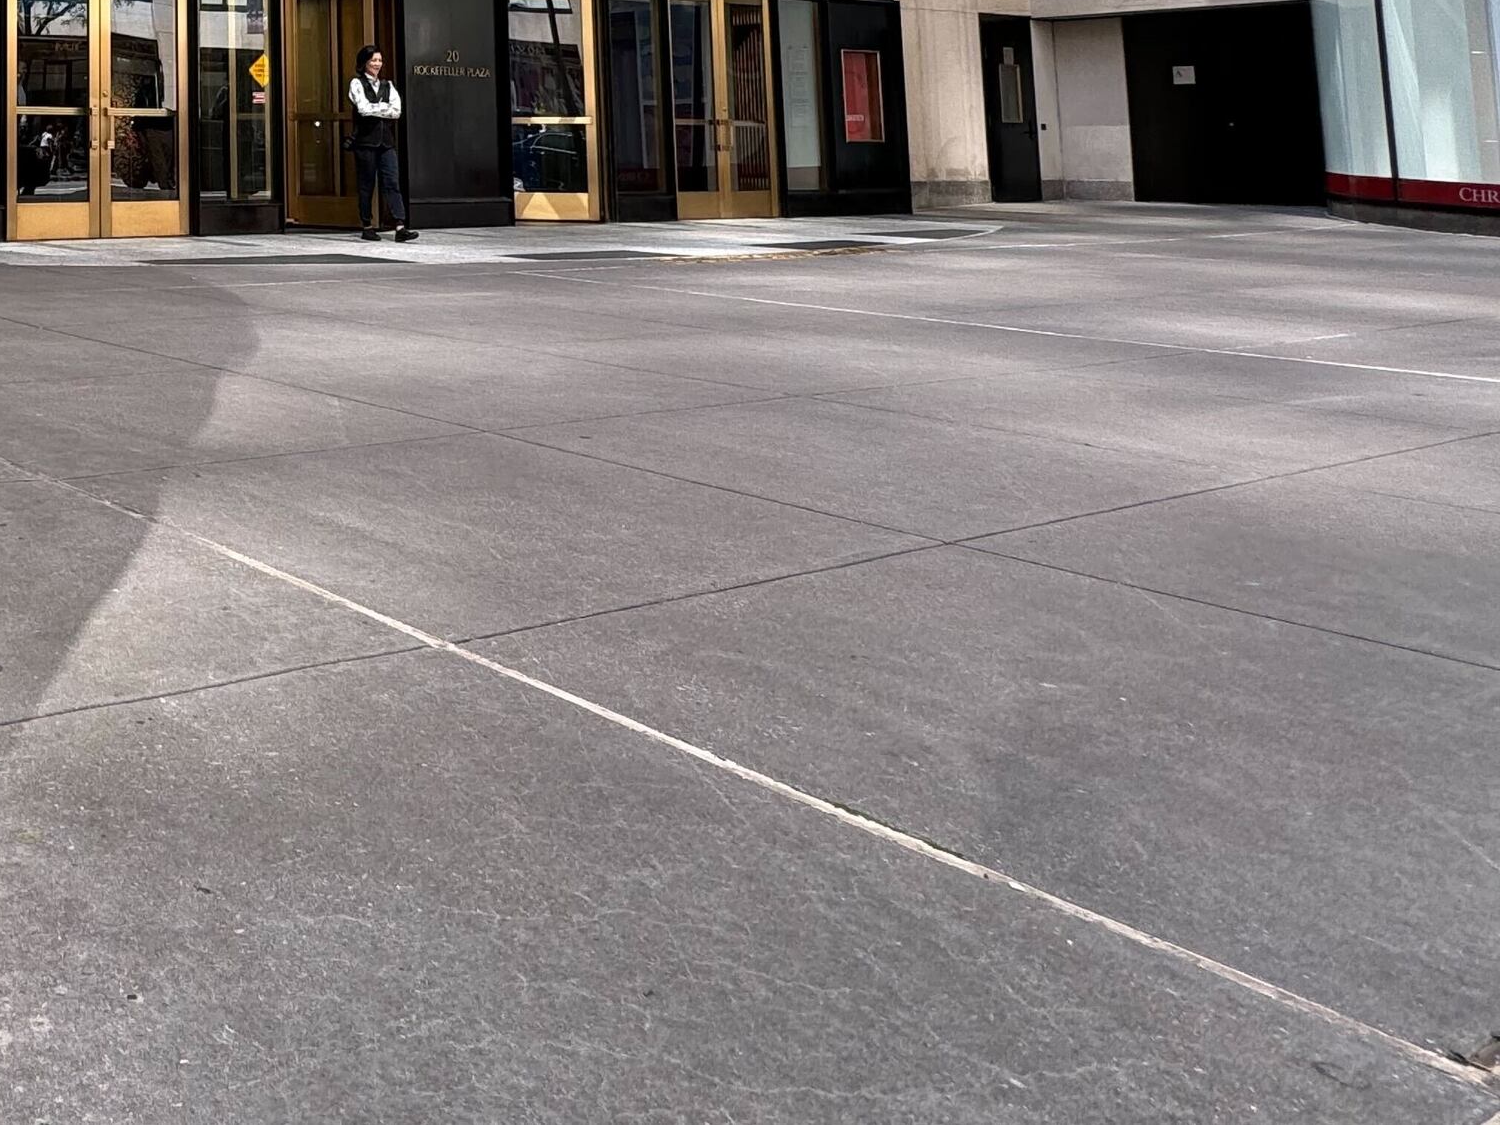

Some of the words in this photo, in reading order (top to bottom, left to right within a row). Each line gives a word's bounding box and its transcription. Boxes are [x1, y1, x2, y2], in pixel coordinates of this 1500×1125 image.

[446, 50, 460, 63] 20
[413, 65, 465, 76] ROCKEFELLER
[466, 67, 491, 78] PLAZA
[1458, 187, 1500, 204] CHR
